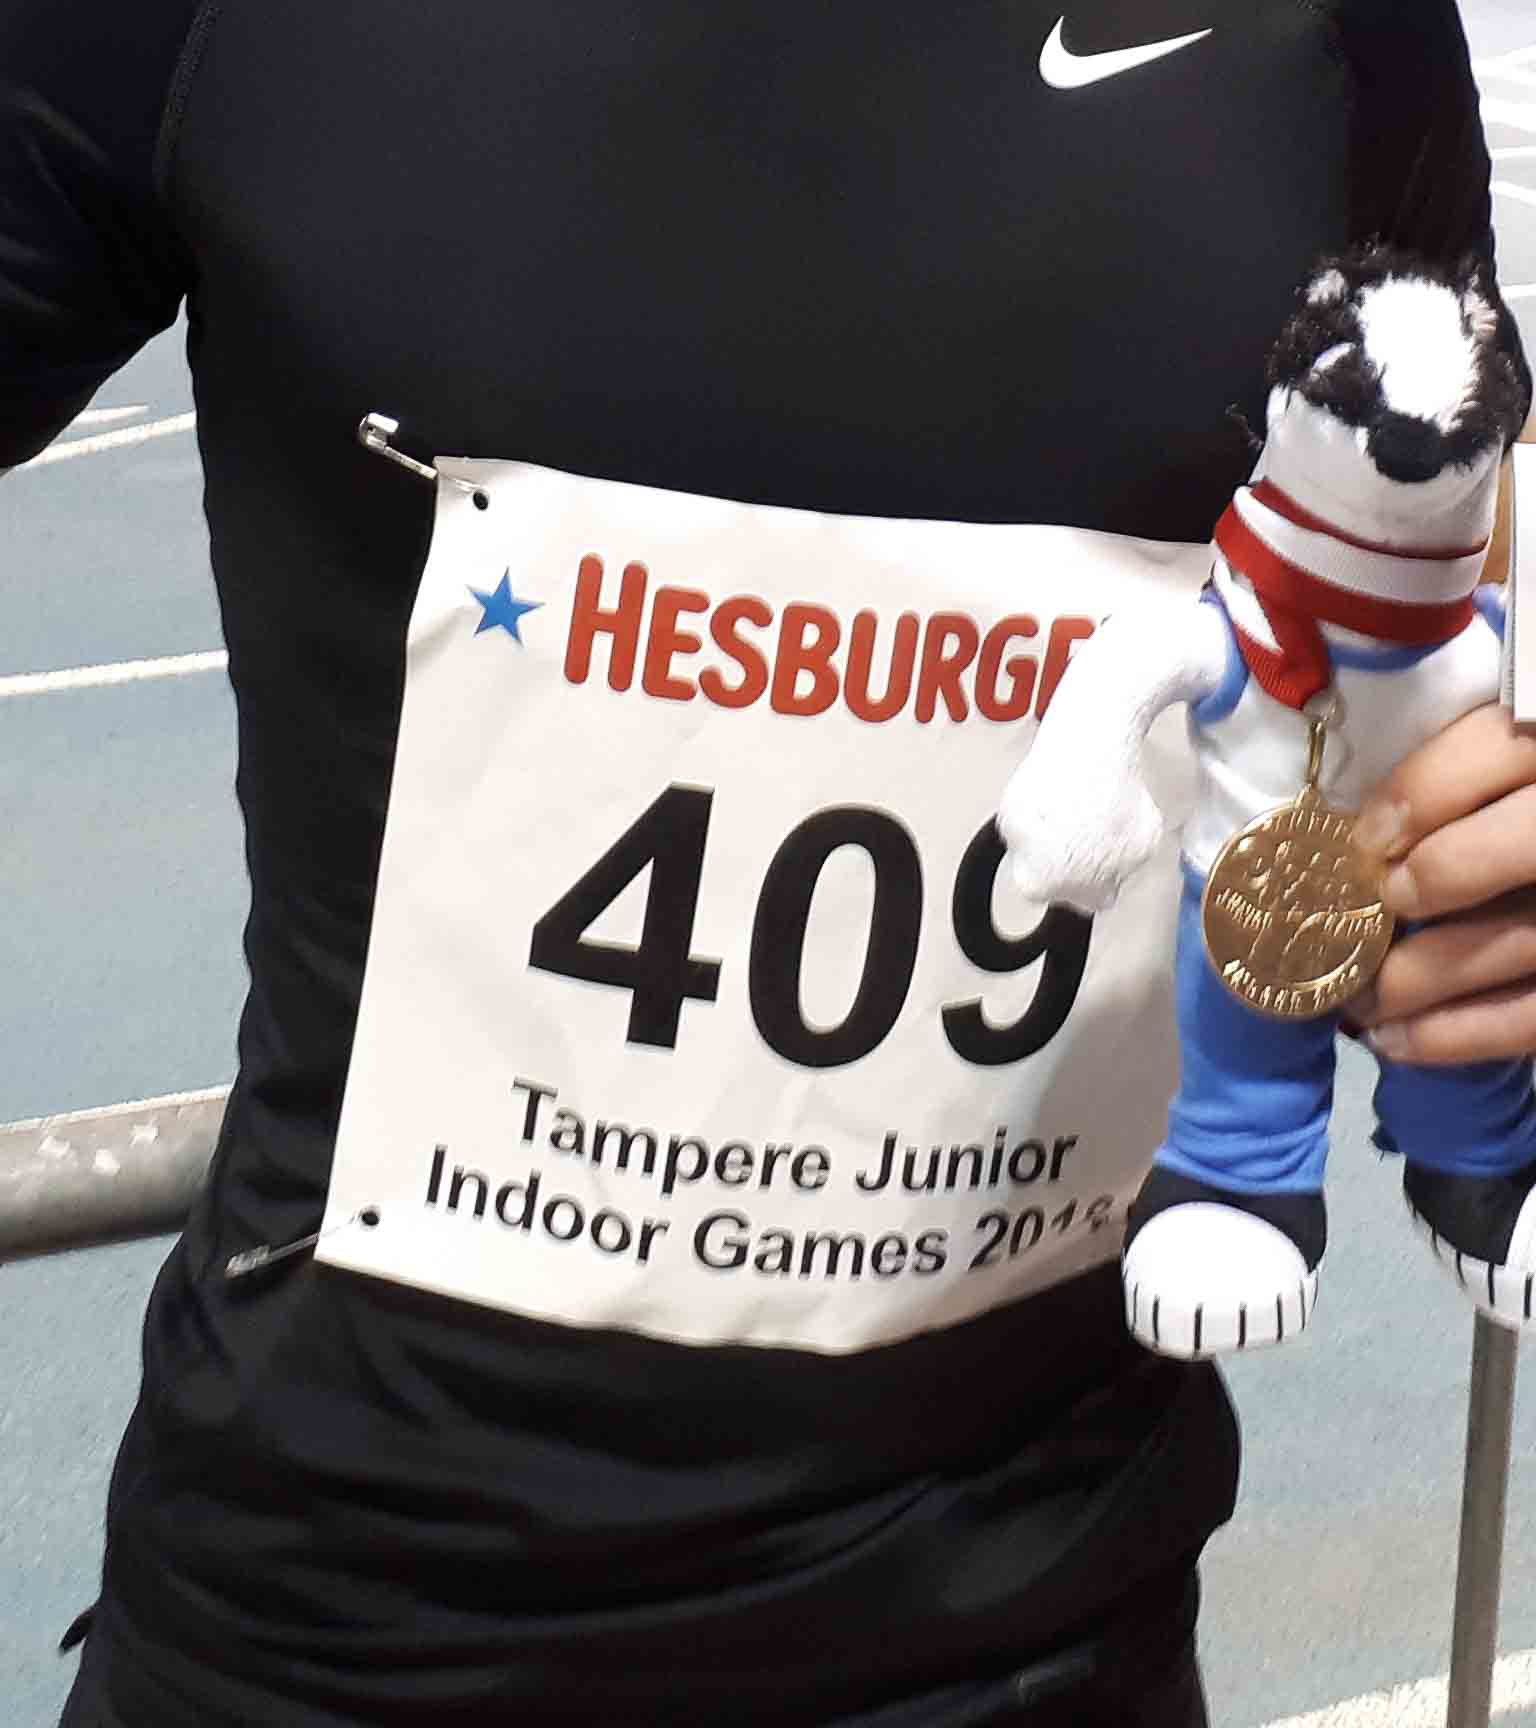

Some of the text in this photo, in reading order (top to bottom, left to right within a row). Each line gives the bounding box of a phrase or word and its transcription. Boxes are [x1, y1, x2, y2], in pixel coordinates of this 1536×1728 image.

[528, 782, 1095, 1069] 409
[512, 1076, 1077, 1197] Tampere Junior
[424, 1144, 670, 1262] Indoor
[692, 1209, 948, 1280] Games
